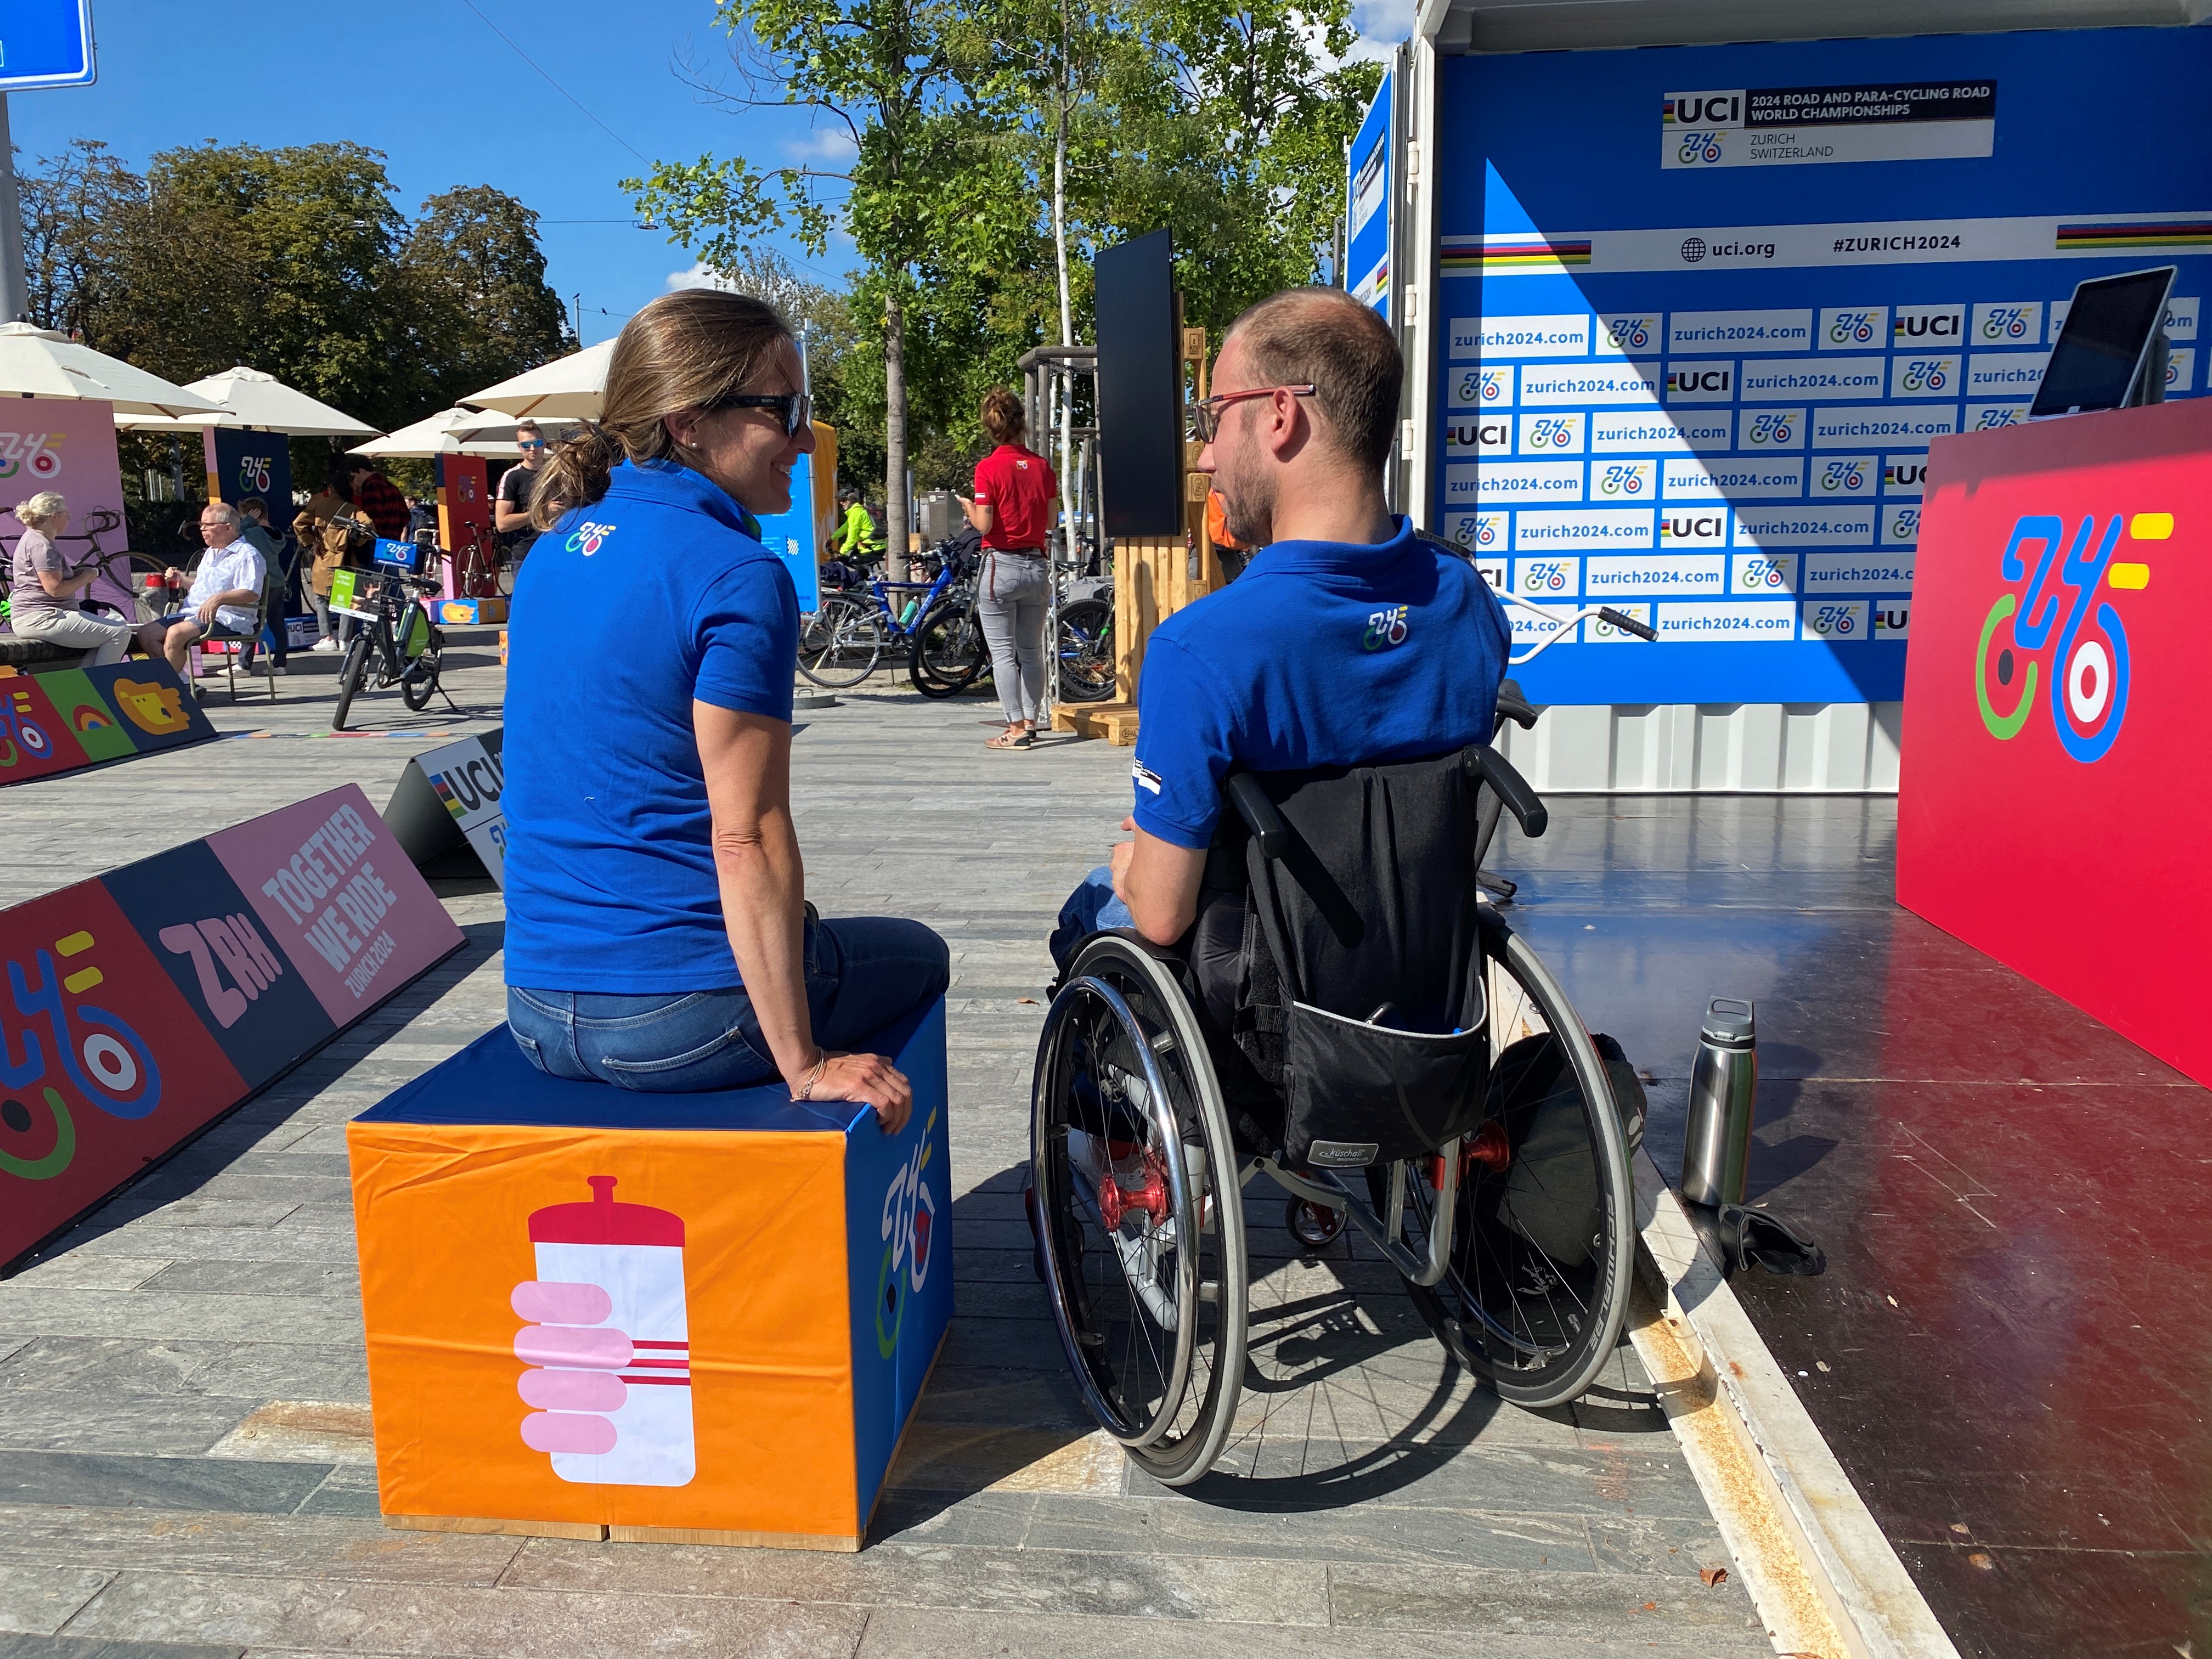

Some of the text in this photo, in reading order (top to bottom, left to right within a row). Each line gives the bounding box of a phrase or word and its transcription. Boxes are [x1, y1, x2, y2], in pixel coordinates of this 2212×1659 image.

[1751, 86, 1990, 106] 2024 ROAD AND PARA-CYCLING ROAD
[1678, 97, 1740, 124] UCI
[1751, 104, 1910, 121] WORLD CHAMPIONSHIPS
[1750, 133, 1796, 145] ZURICH
[1750, 146, 1833, 160] SWITZERLAND
[1712, 241, 1775, 258] uci.org
[1833, 235, 1961, 252] #ZURICH2024
[1907, 315, 1959, 336] UCI
[1455, 332, 1583, 347] zurich2024.com
[1674, 326, 1806, 341] zurich2024.com
[1527, 380, 1655, 393] zurich2024.com
[1679, 371, 1729, 392] UCI
[1746, 374, 1878, 388] zurich2024.com
[1458, 426, 1506, 446] UCI
[1598, 427, 1726, 440] zurich2024.com
[1818, 422, 1951, 436] zurich2024.com
[1451, 478, 1578, 492] zurich2024.com
[1669, 473, 1798, 487] zurich2024.com
[1521, 525, 1649, 538] zurich2024.com
[1673, 518, 1721, 537] UCI
[1740, 521, 1869, 534] zurich2024.com
[1592, 571, 1719, 584] zurich2024.com
[1810, 567, 1914, 581] zurich2024.c
[1662, 617, 1790, 630] zurich2024.com
[442, 757, 504, 811] UCI
[261, 803, 376, 926] TOGETHER
[304, 861, 398, 974] WE RIDE
[344, 929, 397, 1000] ZURICH 2024
[1330, 1148, 1363, 1157] küschall
[1590, 1193, 1615, 1351] SCHWALBE
